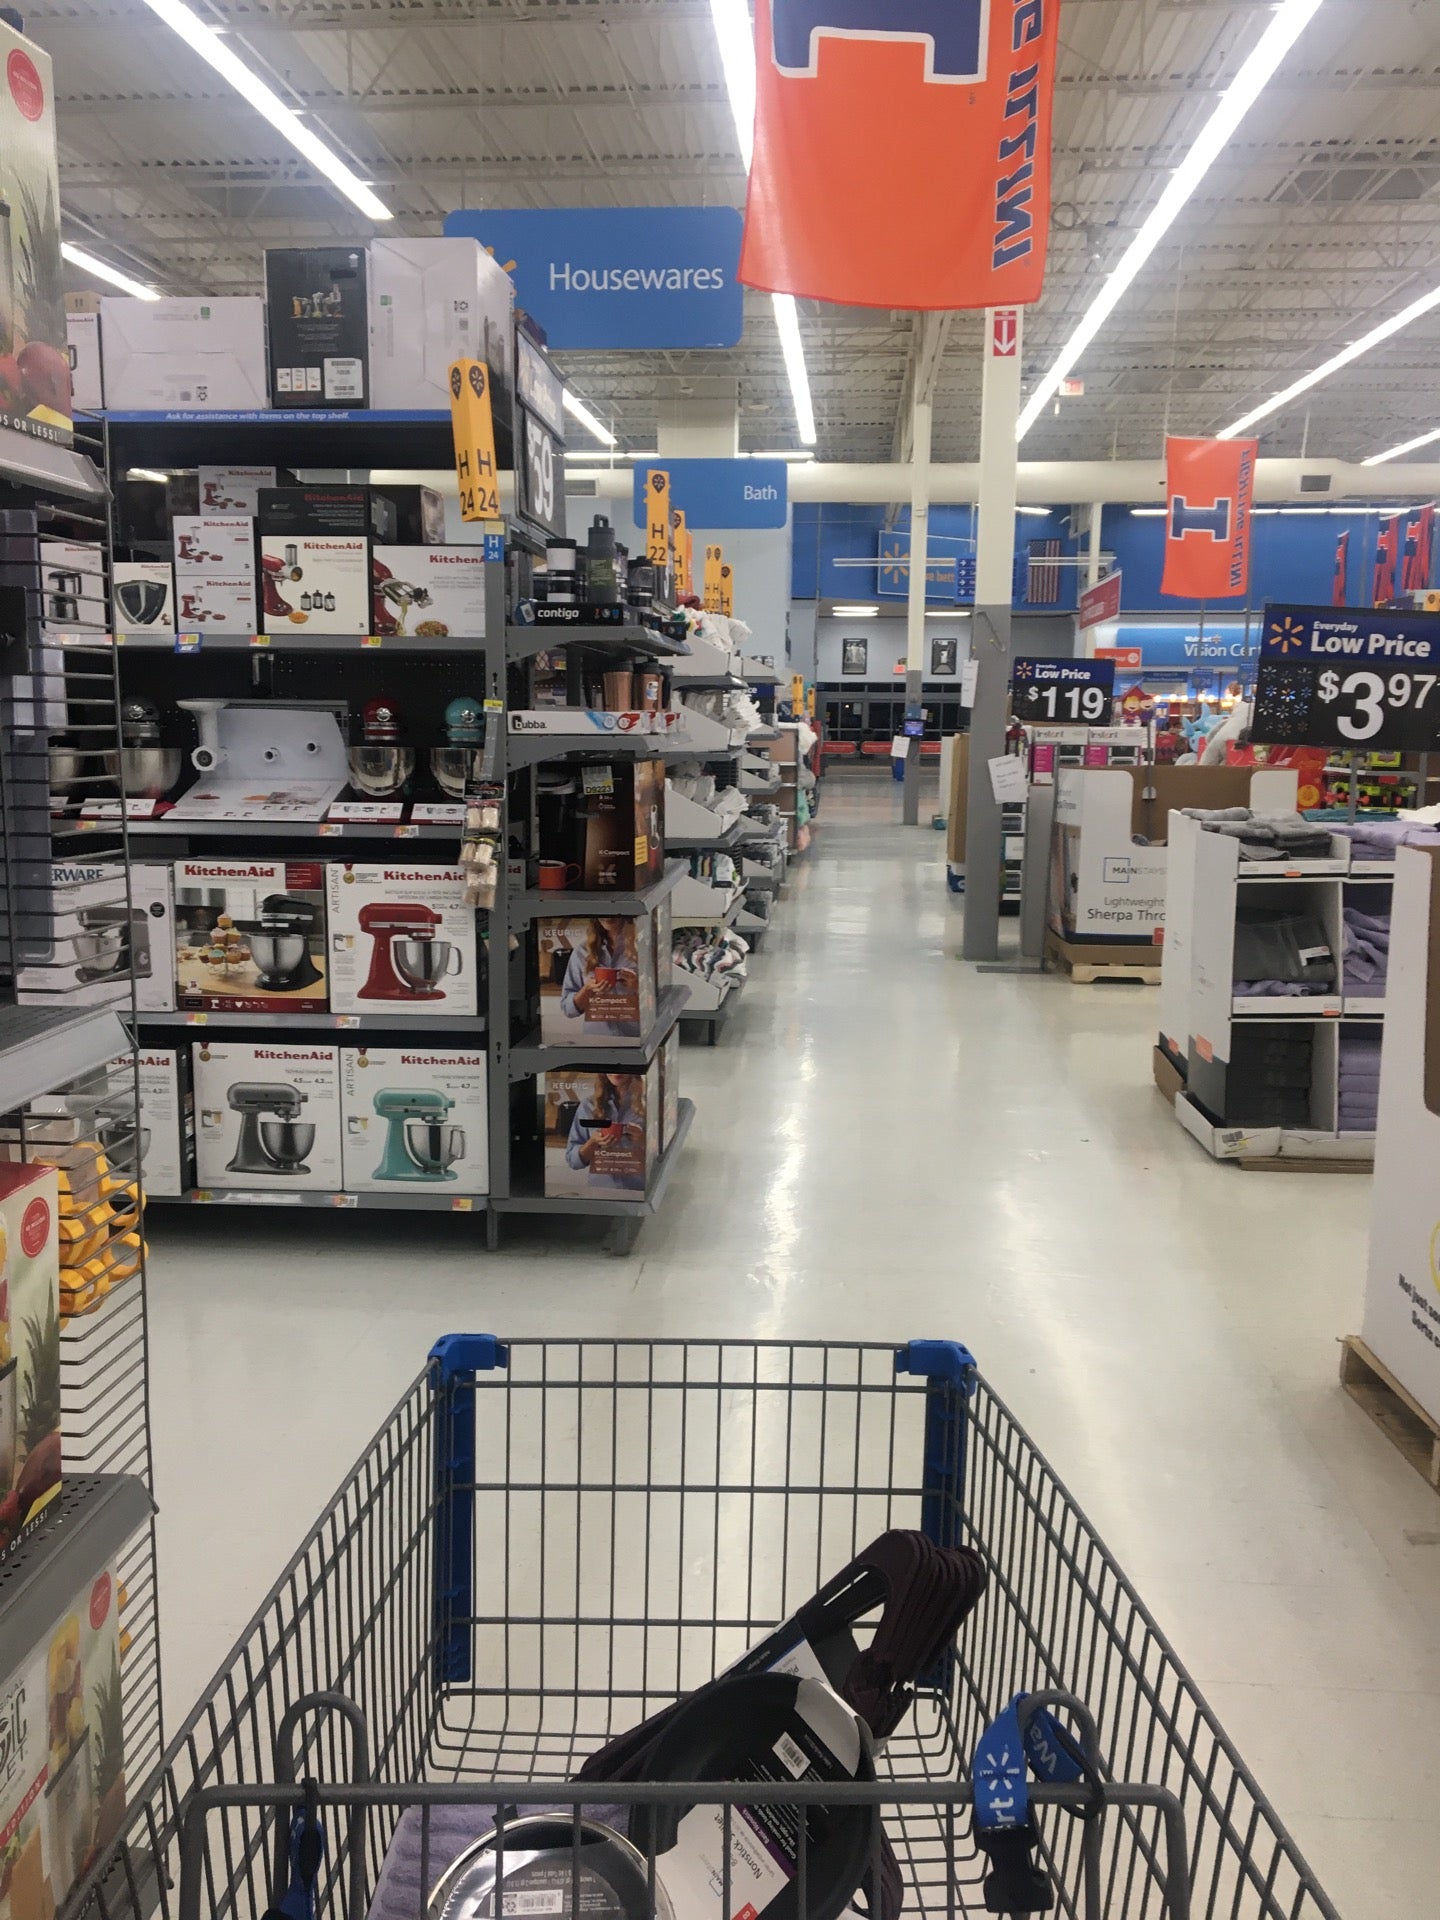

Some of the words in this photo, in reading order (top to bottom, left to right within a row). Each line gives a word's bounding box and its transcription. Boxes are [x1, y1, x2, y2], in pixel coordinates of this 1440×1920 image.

[549, 261, 724, 291] Housewares
[165, 411, 181, 420] Ask
[182, 411, 195, 420] for
[196, 411, 239, 420] assistance
[240, 411, 258, 420] with
[259, 411, 282, 420] items
[283, 412, 296, 420] on
[297, 412, 310, 420] the
[311, 412, 327, 422] top
[14, 418, 27, 432] OR
[458, 449, 470, 480] H
[477, 448, 493, 478] H
[743, 484, 778, 501] Bath
[459, 487, 475, 517] 24
[478, 486, 499, 514] 24
[203, 520, 249, 528] KitchenAid
[651, 523, 664, 540] H
[303, 541, 364, 551] KitchenAid
[488, 535, 499, 548] H
[488, 550, 499, 561] 24
[650, 546, 667, 562] 22
[206, 580, 251, 588] KitchenAid
[537, 607, 580, 620] contigo
[1313, 620, 1359, 633] Everyday
[1184, 643, 1227, 657] Vision
[1310, 631, 1365, 655] Low
[1367, 633, 1432, 658] Price
[1034, 668, 1061, 679] Low
[1061, 668, 1091, 680] Price
[184, 864, 276, 877] KitchenAid
[331, 868, 339, 914] ARTISAN
[1103, 896, 1165, 908] Lightweight
[1087, 908, 1133, 922] Sherpa
[254, 1049, 334, 1061] KitchenAid
[400, 1055, 481, 1066] KitchenAid
[345, 1054, 354, 1097] ARTISAN
[10, 1534, 22, 1552] OR
[732, 1838, 763, 1880] Nonstick
